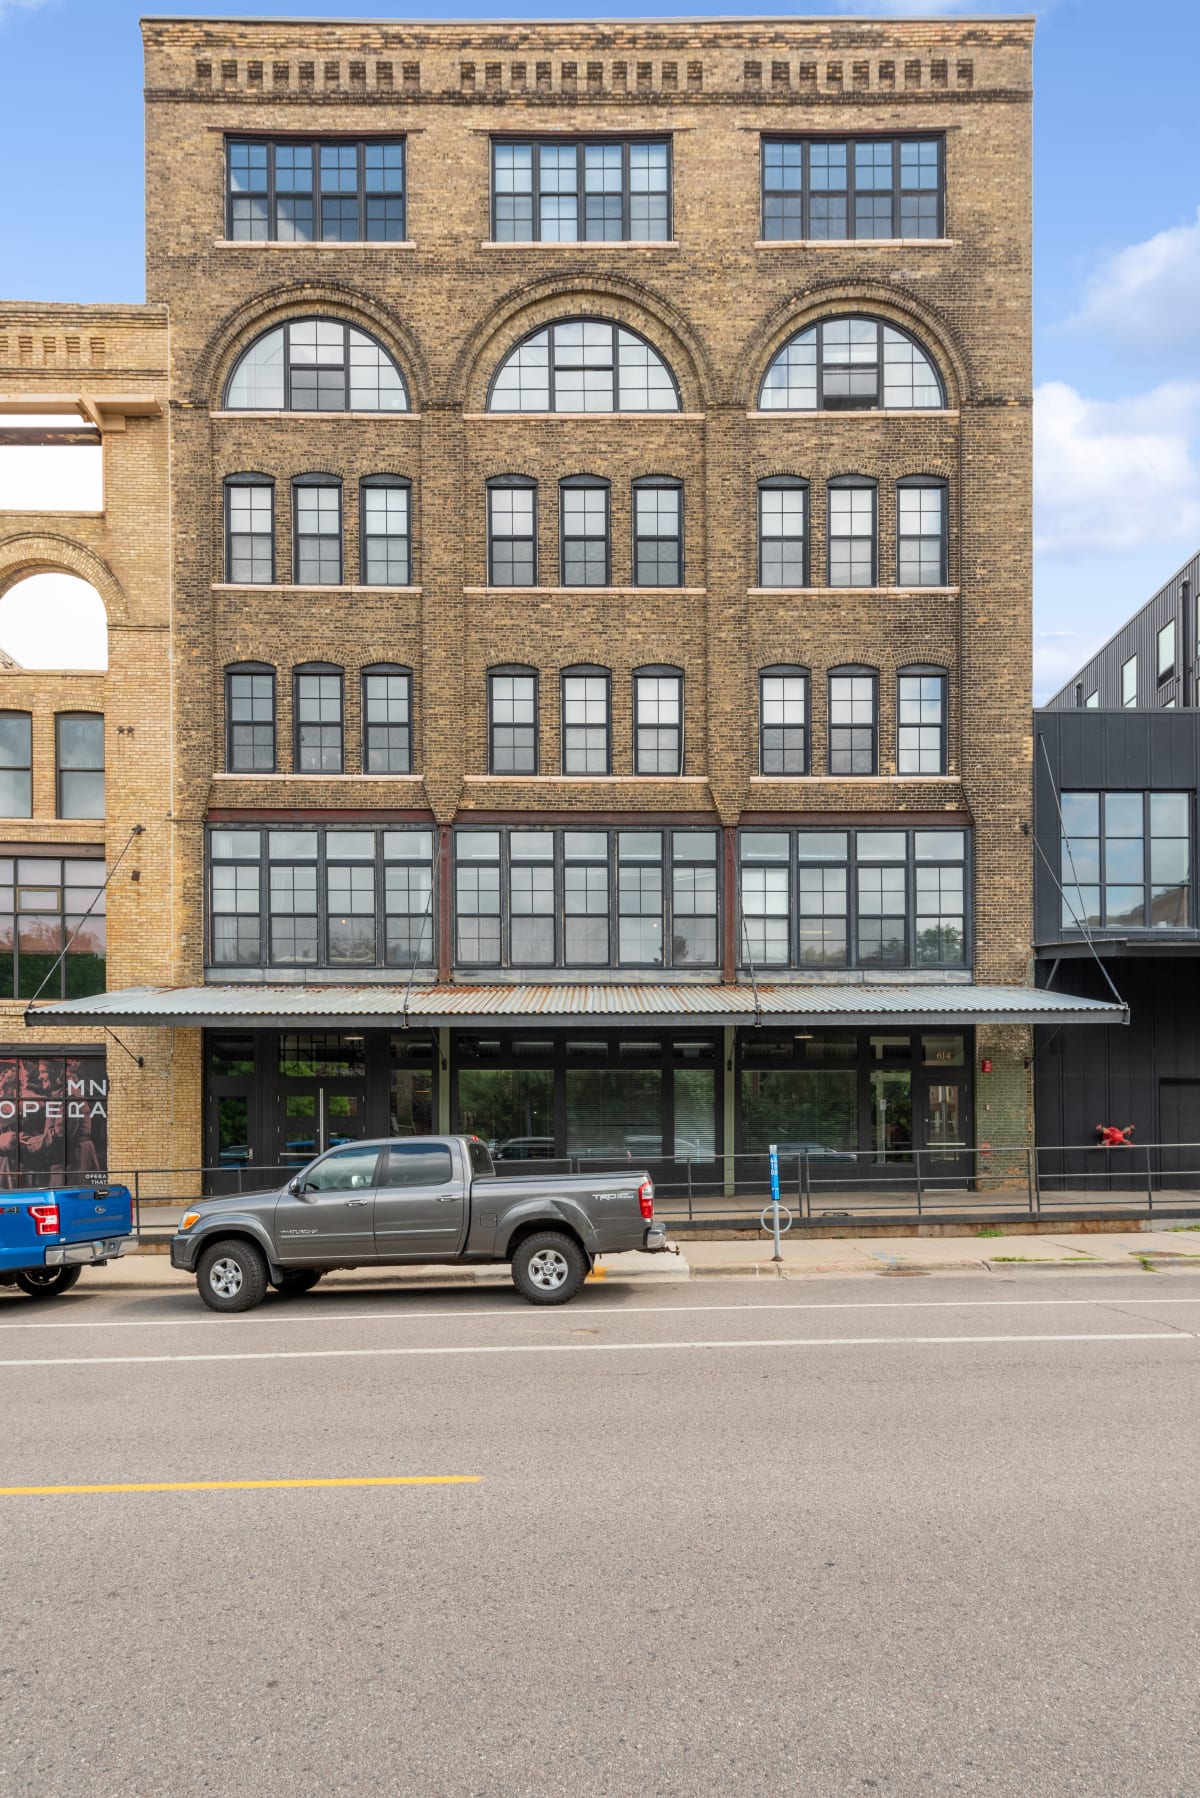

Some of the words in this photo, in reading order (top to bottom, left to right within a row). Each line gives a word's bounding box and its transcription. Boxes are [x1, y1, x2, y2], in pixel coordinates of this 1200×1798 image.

[936, 1051, 951, 1060] 614
[67, 1079, 107, 1096] MN
[0, 1101, 107, 1118] OPERA
